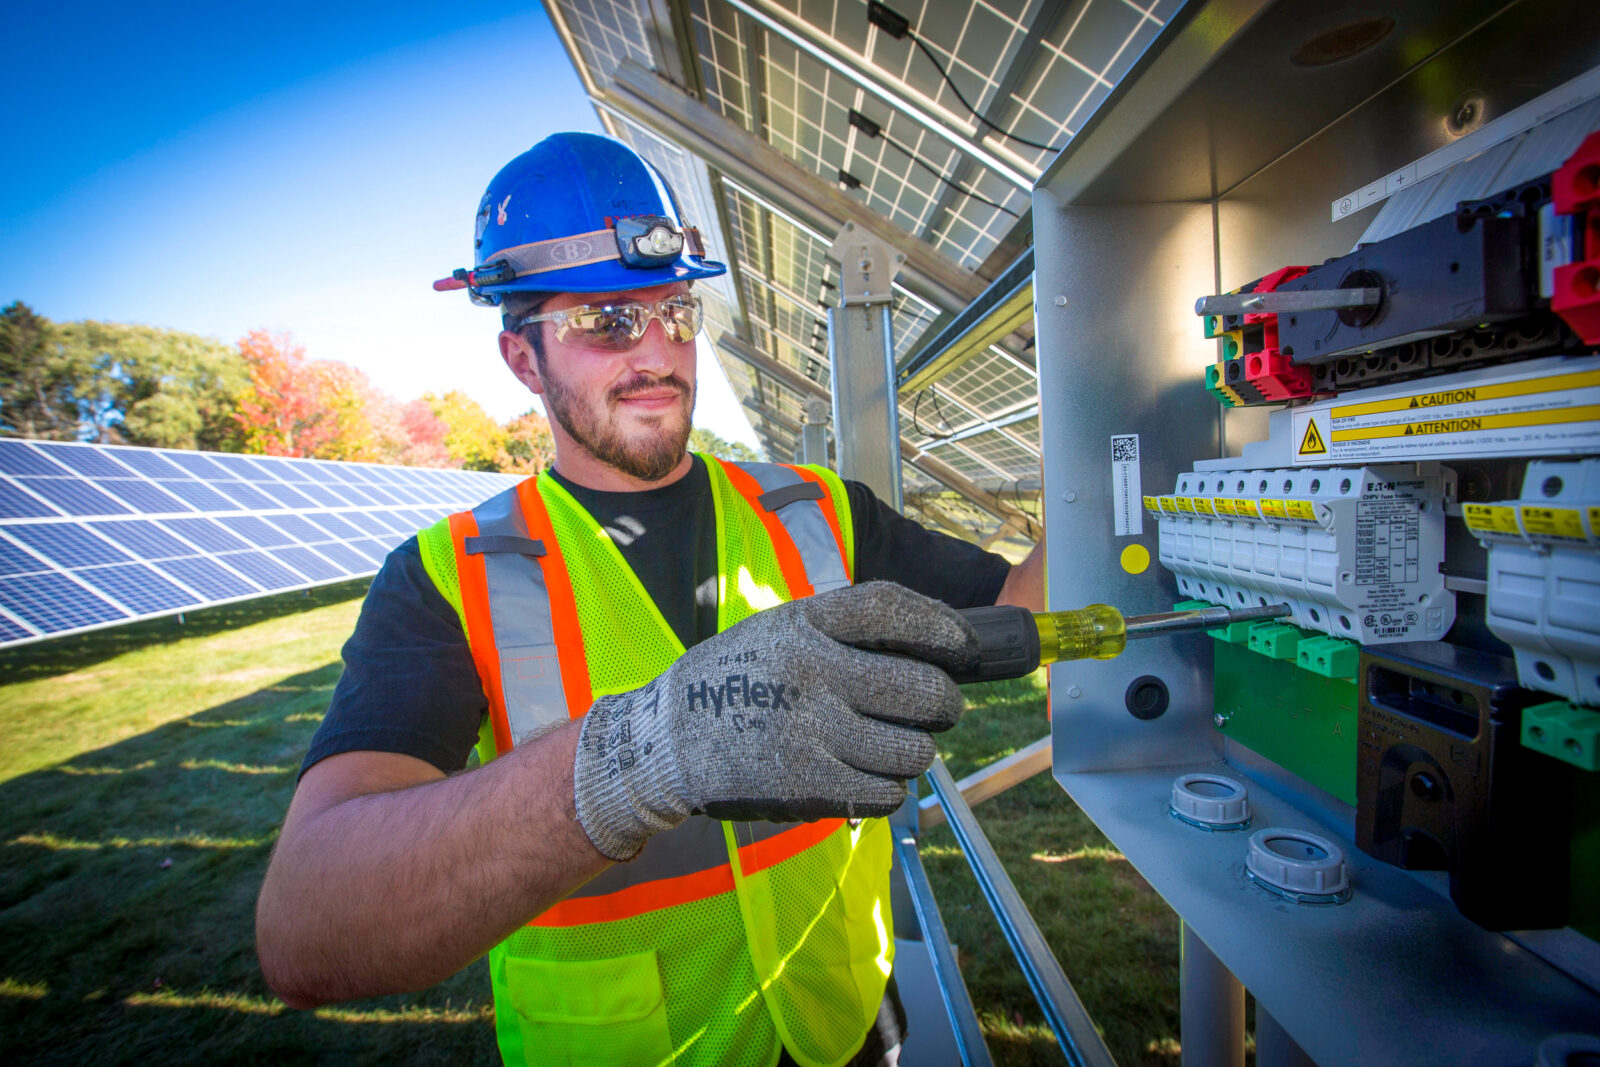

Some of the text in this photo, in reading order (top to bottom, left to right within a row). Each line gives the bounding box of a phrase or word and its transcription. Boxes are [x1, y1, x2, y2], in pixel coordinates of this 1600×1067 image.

[1421, 389, 1476, 407] CAUTION
[1416, 418, 1481, 435] ATTENTION
[718, 650, 758, 667] 11-435
[687, 673, 793, 718] HyFlex
